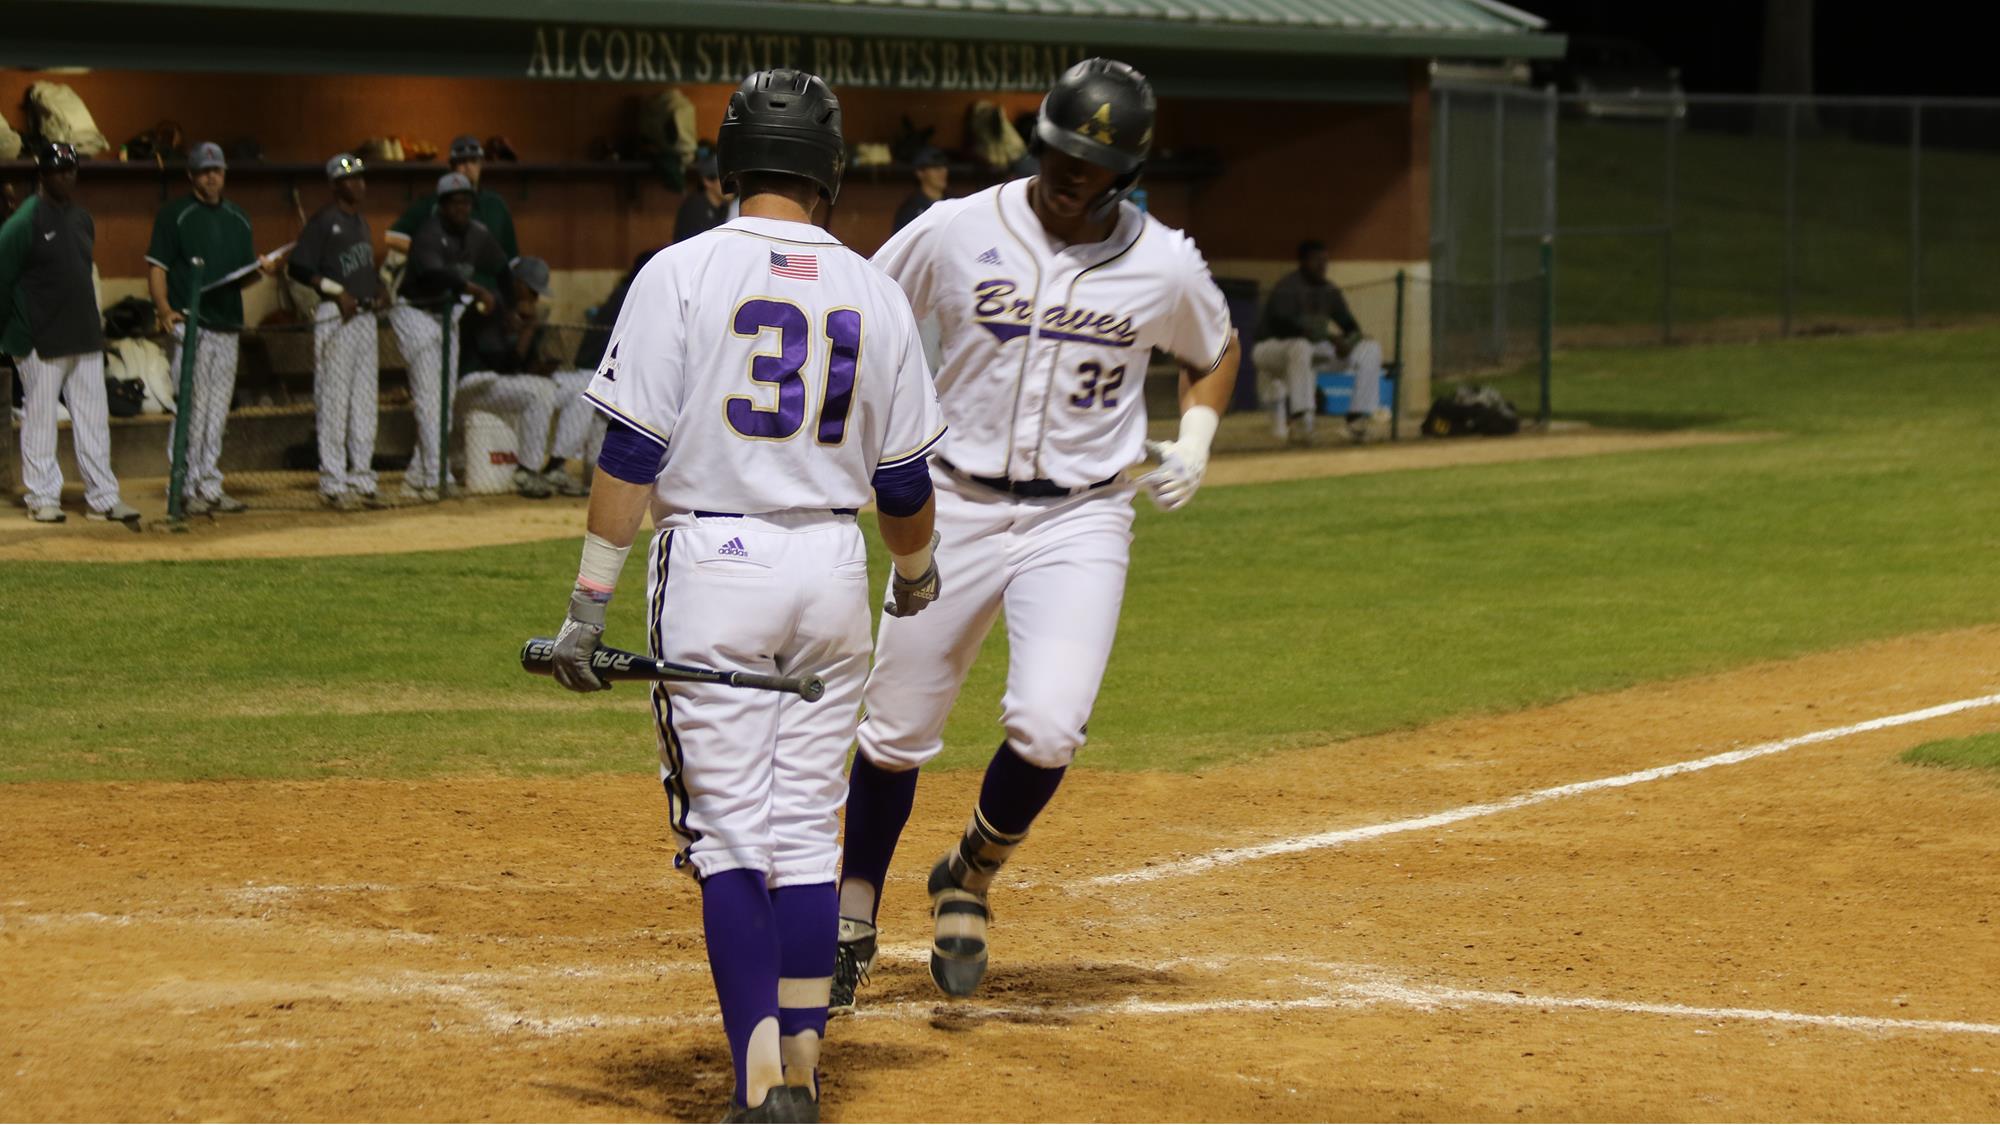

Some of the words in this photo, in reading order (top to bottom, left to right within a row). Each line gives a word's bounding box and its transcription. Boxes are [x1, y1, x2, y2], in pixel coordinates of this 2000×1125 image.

[526, 27, 682, 81] ALCORN
[694, 33, 801, 81] STATE
[813, 36, 937, 88] BRAVES
[940, 40, 1087, 91] BASEBA
[974, 279, 1137, 346] Braves
[722, 295, 863, 447] 31
[1066, 358, 1127, 410] 32
[718, 547, 748, 557] adidas
